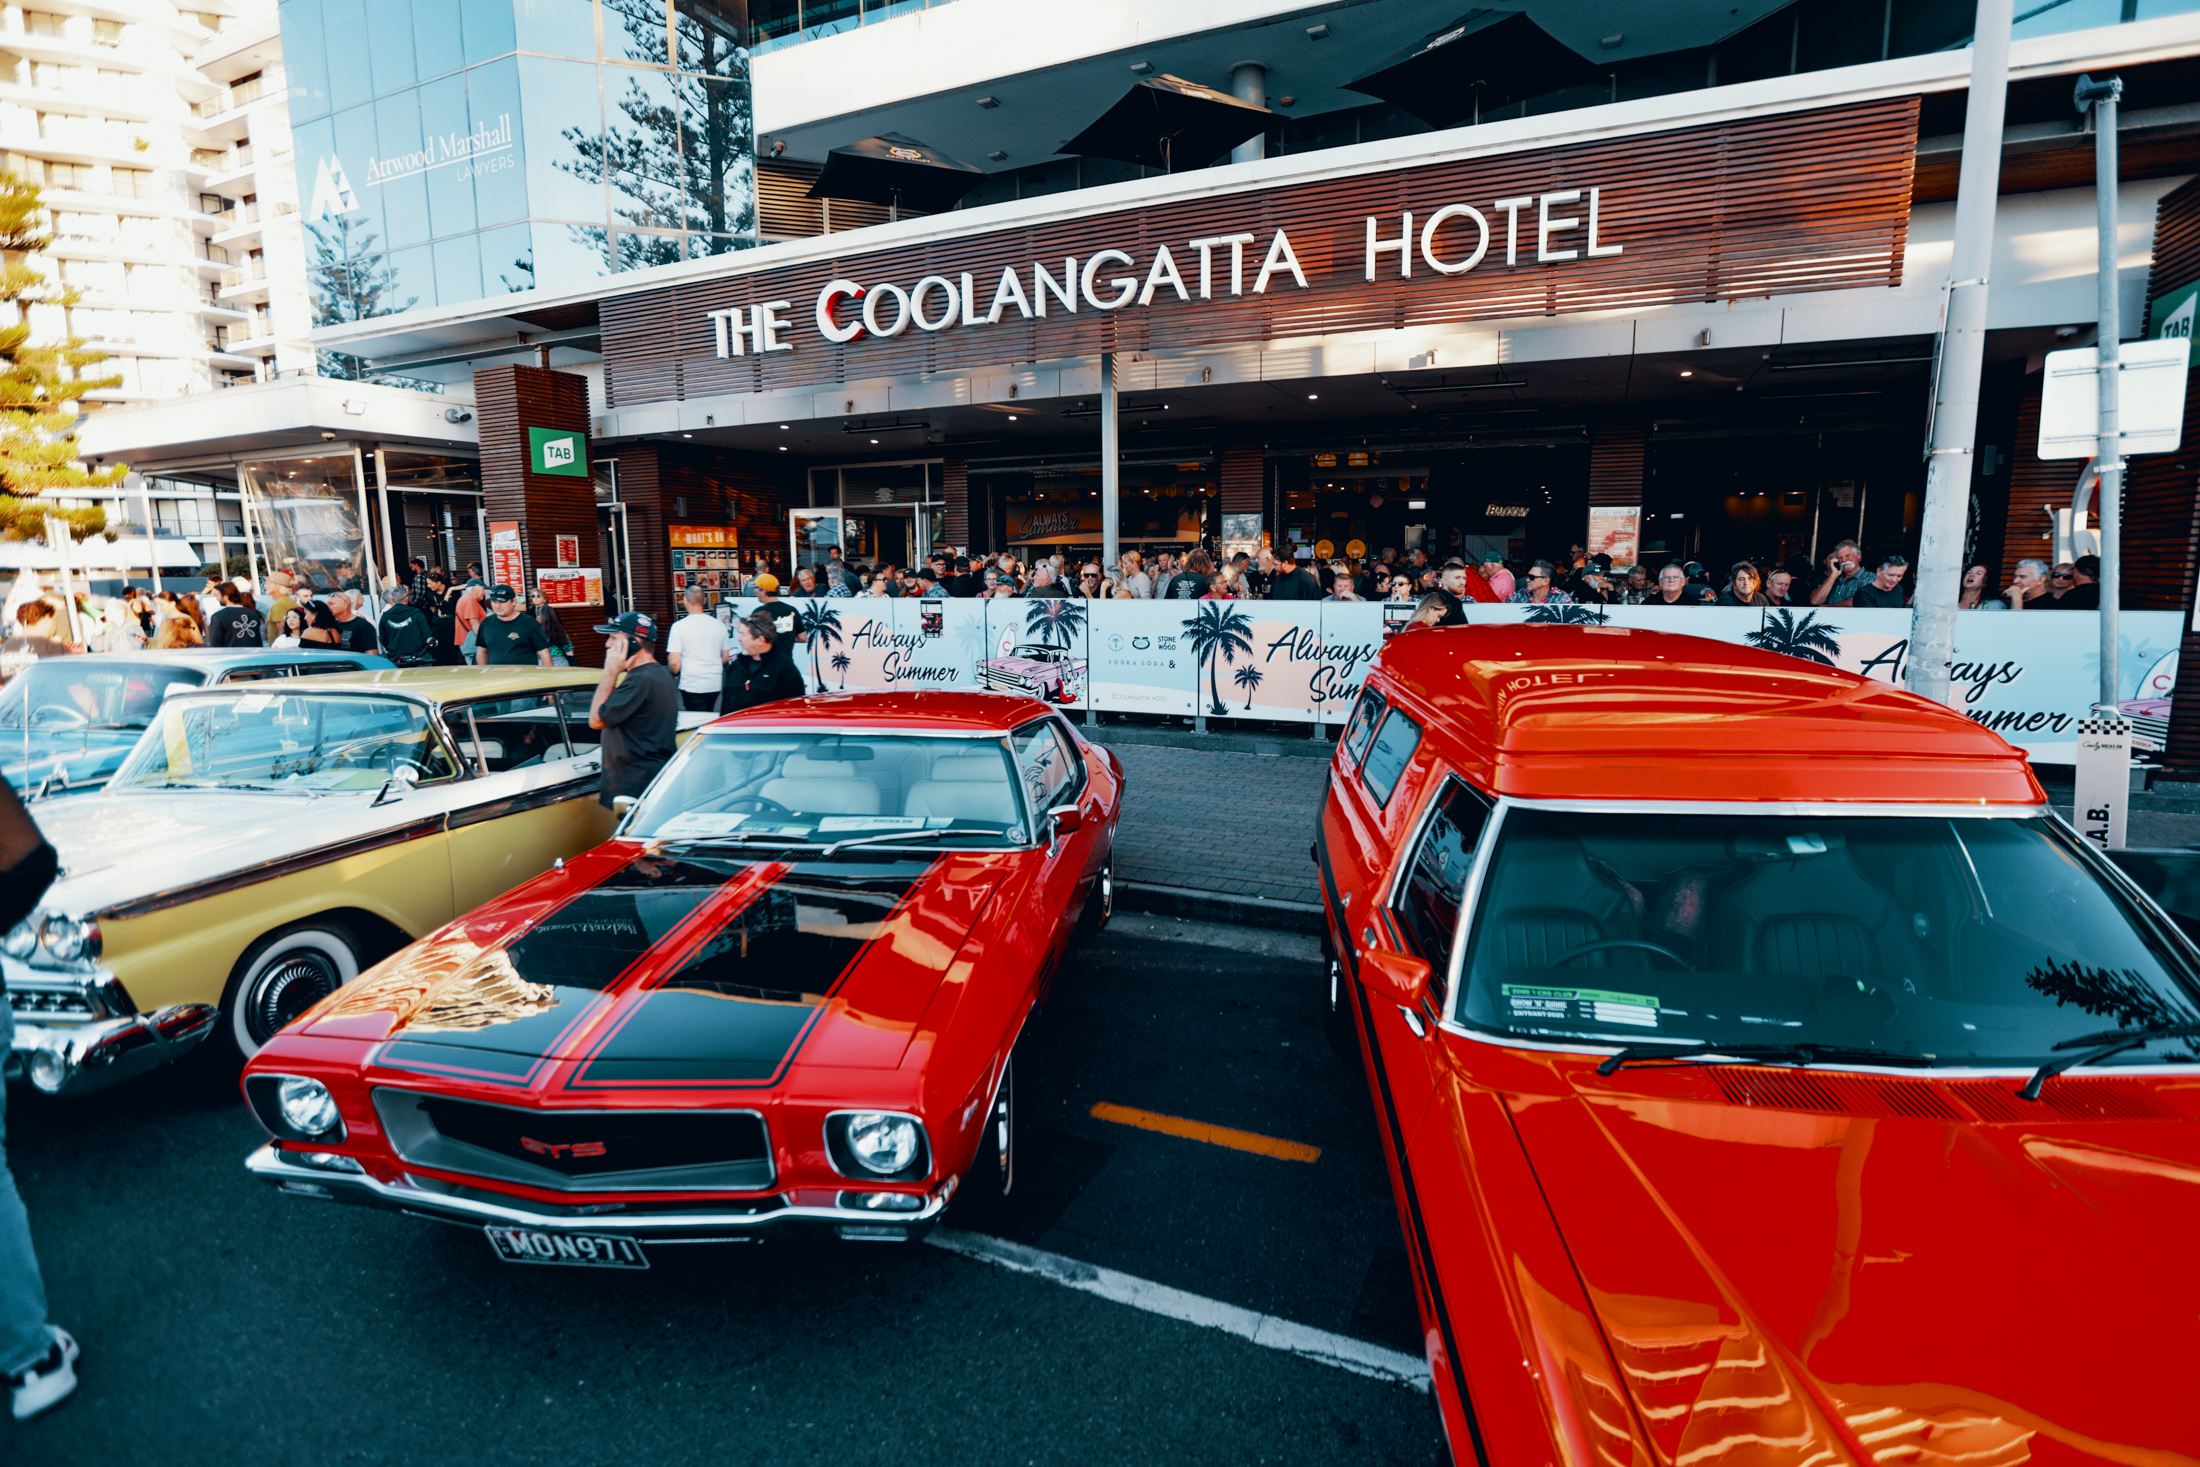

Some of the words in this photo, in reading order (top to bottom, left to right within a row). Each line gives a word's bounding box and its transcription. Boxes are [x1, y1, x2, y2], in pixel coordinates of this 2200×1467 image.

[366, 136, 436, 182] Attwood
[438, 112, 513, 161] Marshall
[456, 154, 515, 182] LAWYERS
[707, 299, 793, 359] THE
[815, 228, 1310, 343] COOLANGATTA
[1365, 187, 1624, 283] HOTEL
[2164, 316, 2190, 338] TAB
[547, 446, 571, 460] TAB
[1019, 515, 1080, 540] Summer
[1033, 510, 1069, 526] ALWAYS
[685, 531, 713, 545] WHAT'S
[714, 531, 725, 543] ON
[852, 618, 928, 662] Always
[1265, 625, 1378, 679] Always
[883, 651, 960, 683] Summer
[1168, 659, 1176, 669] &
[1860, 638, 2024, 703] Aays
[1111, 693, 1149, 701] COOLANGATTA
[1510, 998, 1534, 1007] SHOW
[1545, 1000, 1568, 1009] SHINE
[1513, 1010, 1547, 1018] ENTRANT
[520, 1136, 607, 1159] GTS
[505, 1230, 636, 1263] MON971
